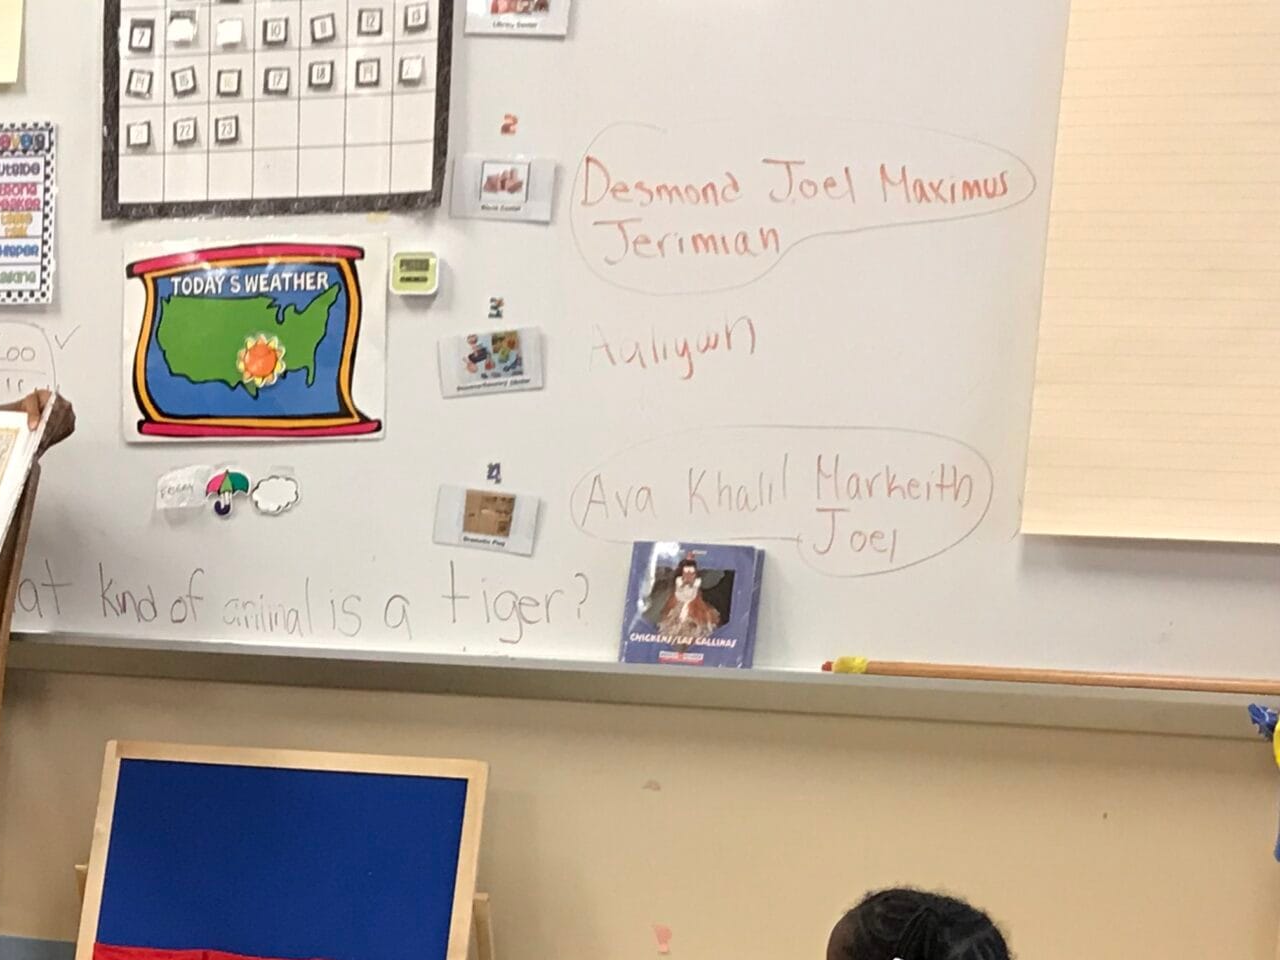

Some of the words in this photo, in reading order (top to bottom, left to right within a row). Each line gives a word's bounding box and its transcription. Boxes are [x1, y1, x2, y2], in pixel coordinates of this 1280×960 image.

[138, 31, 146, 44] 7
[270, 25, 282, 37] 10
[366, 15, 376, 28] 12
[273, 73, 284, 87] 17
[316, 67, 326, 80] 18
[178, 125, 191, 137] 22
[221, 123, 233, 136] 23
[501, 113, 518, 135] 2
[579, 155, 740, 207] Desmond
[762, 157, 857, 204] Joel
[880, 162, 1009, 205] Maximus
[245, 271, 329, 293] WEATHER
[487, 462, 502, 484] 4
[581, 473, 657, 528] Ava
[687, 453, 788, 516] Khalil
[815, 453, 975, 508] Markeith
[813, 507, 898, 563] Joel
[17, 559, 74, 618] at
[170, 568, 205, 624] of
[330, 589, 362, 637] is
[384, 593, 413, 640] a
[442, 560, 591, 644] tiger?
